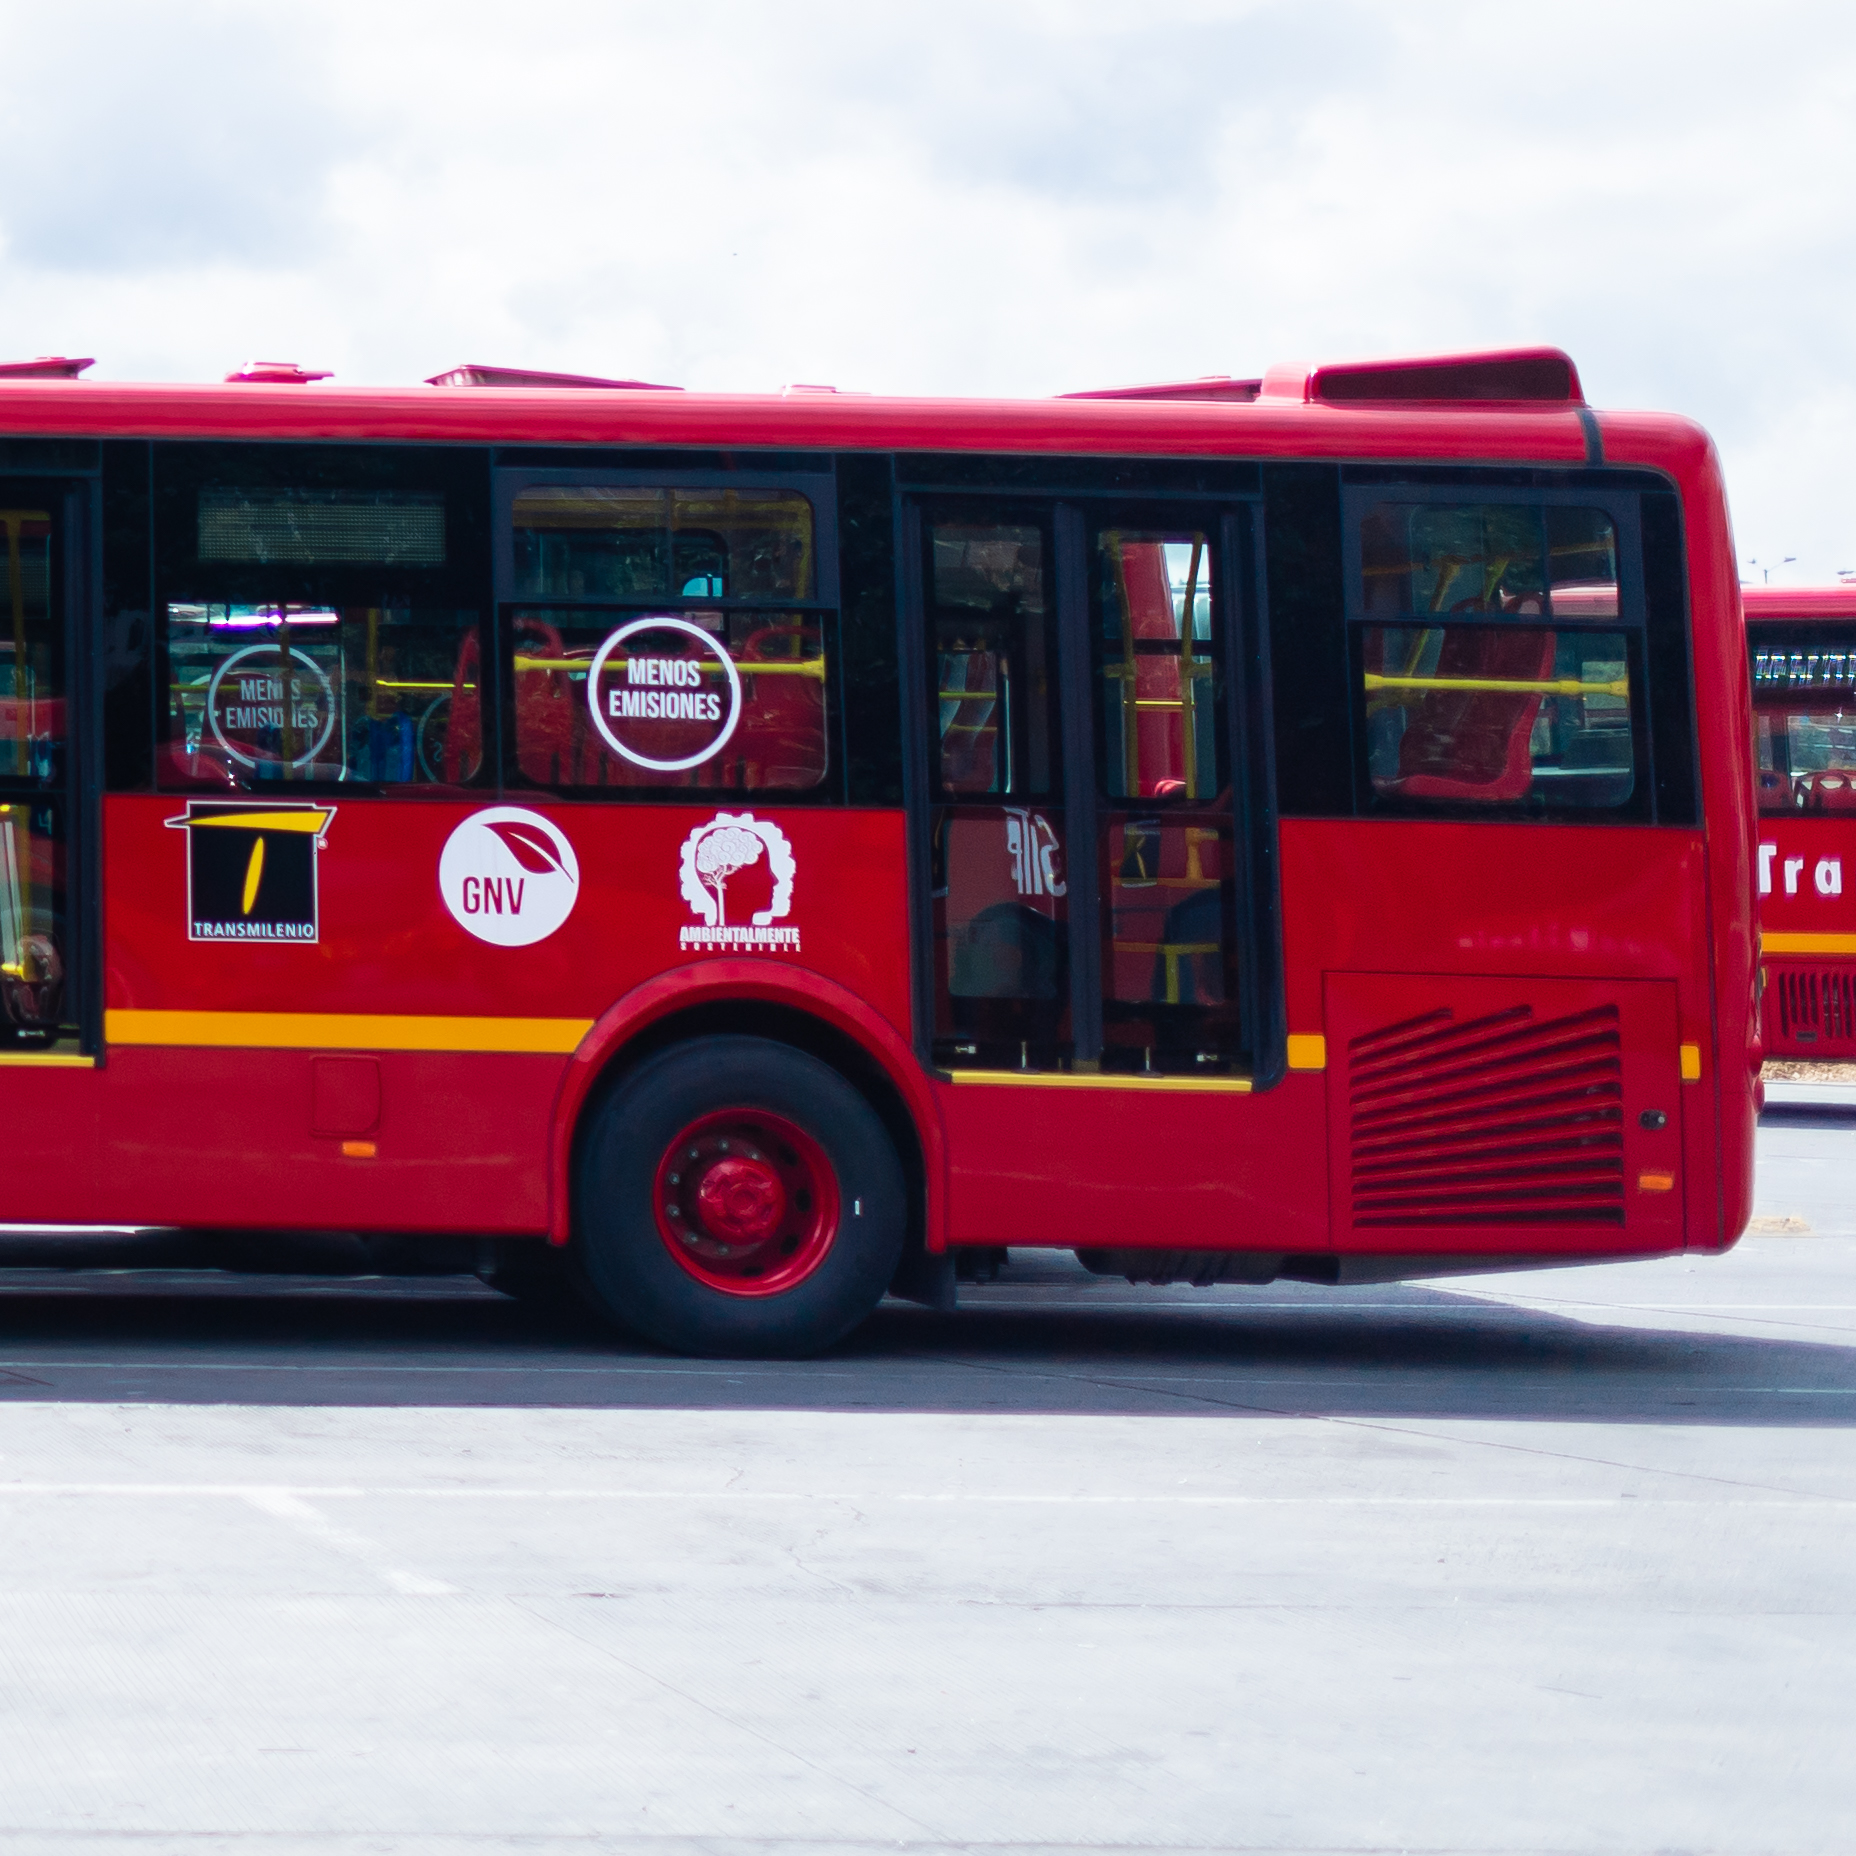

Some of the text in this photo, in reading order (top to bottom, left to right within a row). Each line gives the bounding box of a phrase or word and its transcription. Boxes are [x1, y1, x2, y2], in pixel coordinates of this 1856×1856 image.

[628, 658, 701, 687] MENOS
[609, 690, 721, 721] EMISIONES
[462, 876, 525, 915] GNV
[194, 922, 314, 938] TRANSMILENIO
[679, 926, 800, 943] AMBIENTALMENTE
